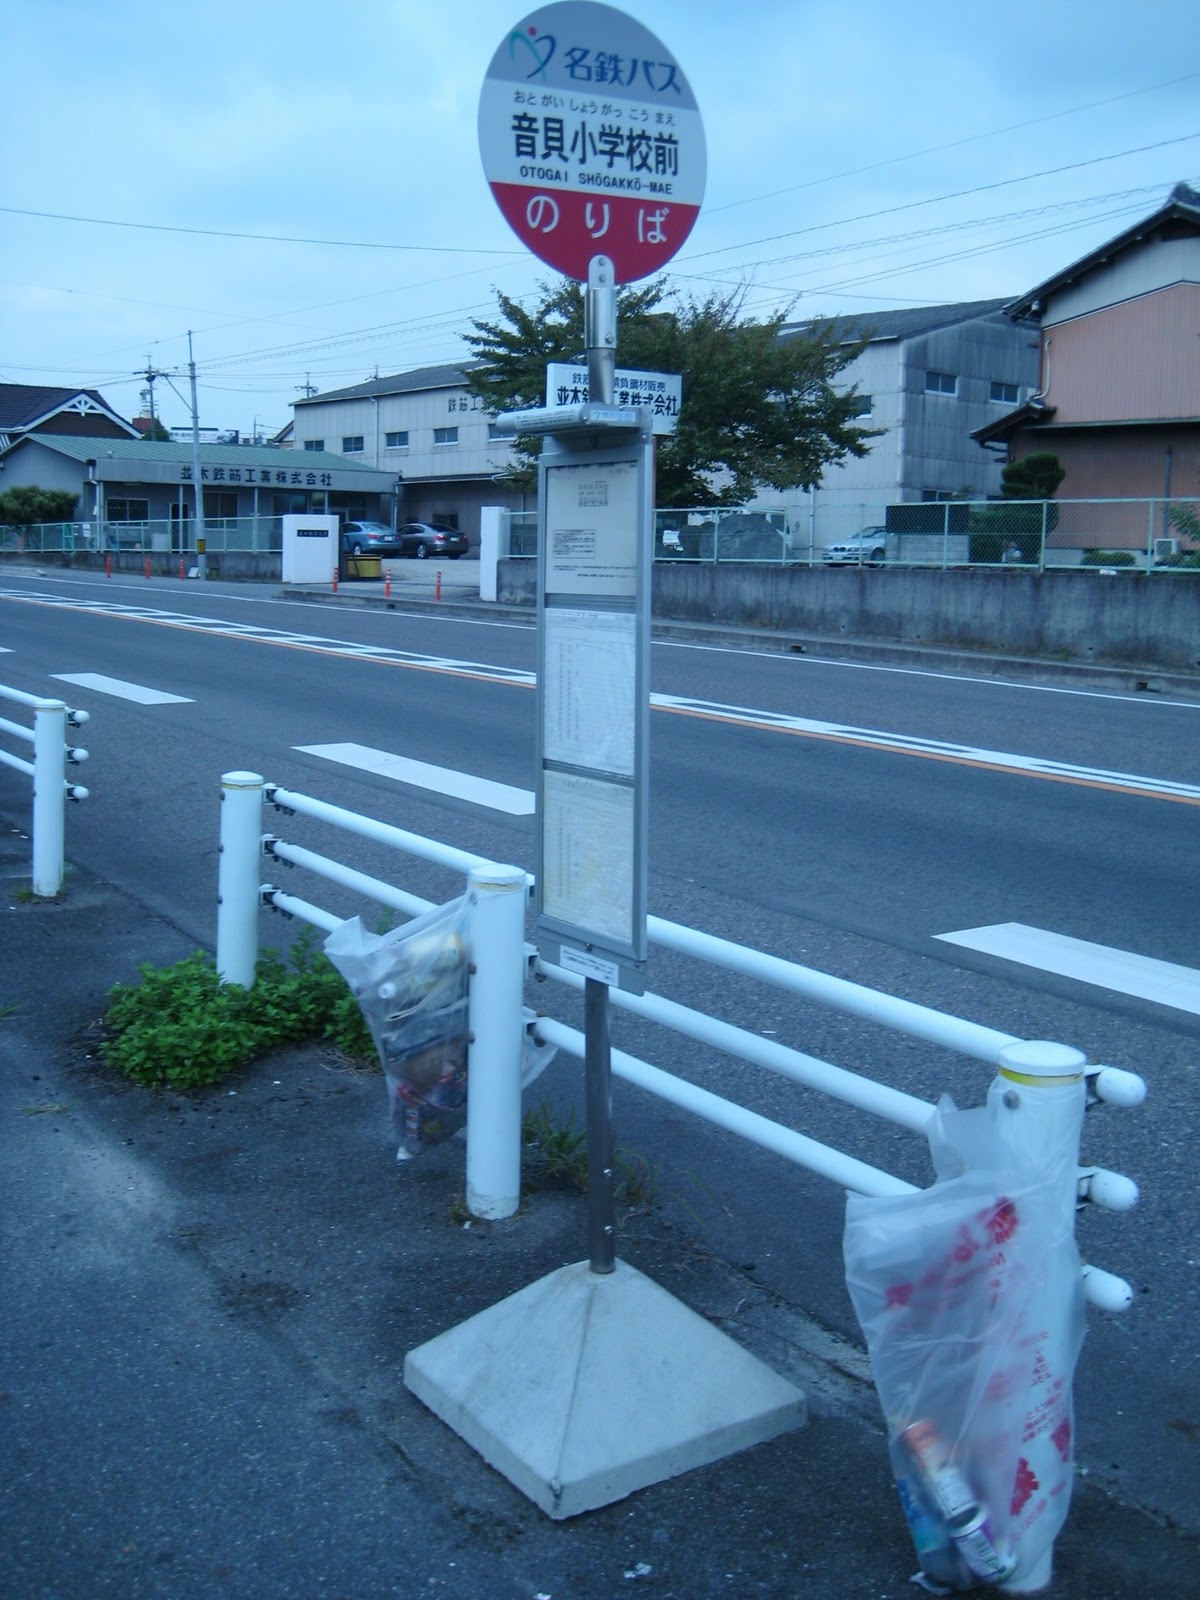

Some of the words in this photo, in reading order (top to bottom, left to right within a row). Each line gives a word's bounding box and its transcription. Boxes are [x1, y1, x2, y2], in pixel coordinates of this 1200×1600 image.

[564, 46, 681, 95] 名鉄バス
[511, 112, 679, 177] 音貝小学校前
[520, 165, 568, 182] OTOGAI
[526, 195, 669, 244] のりば
